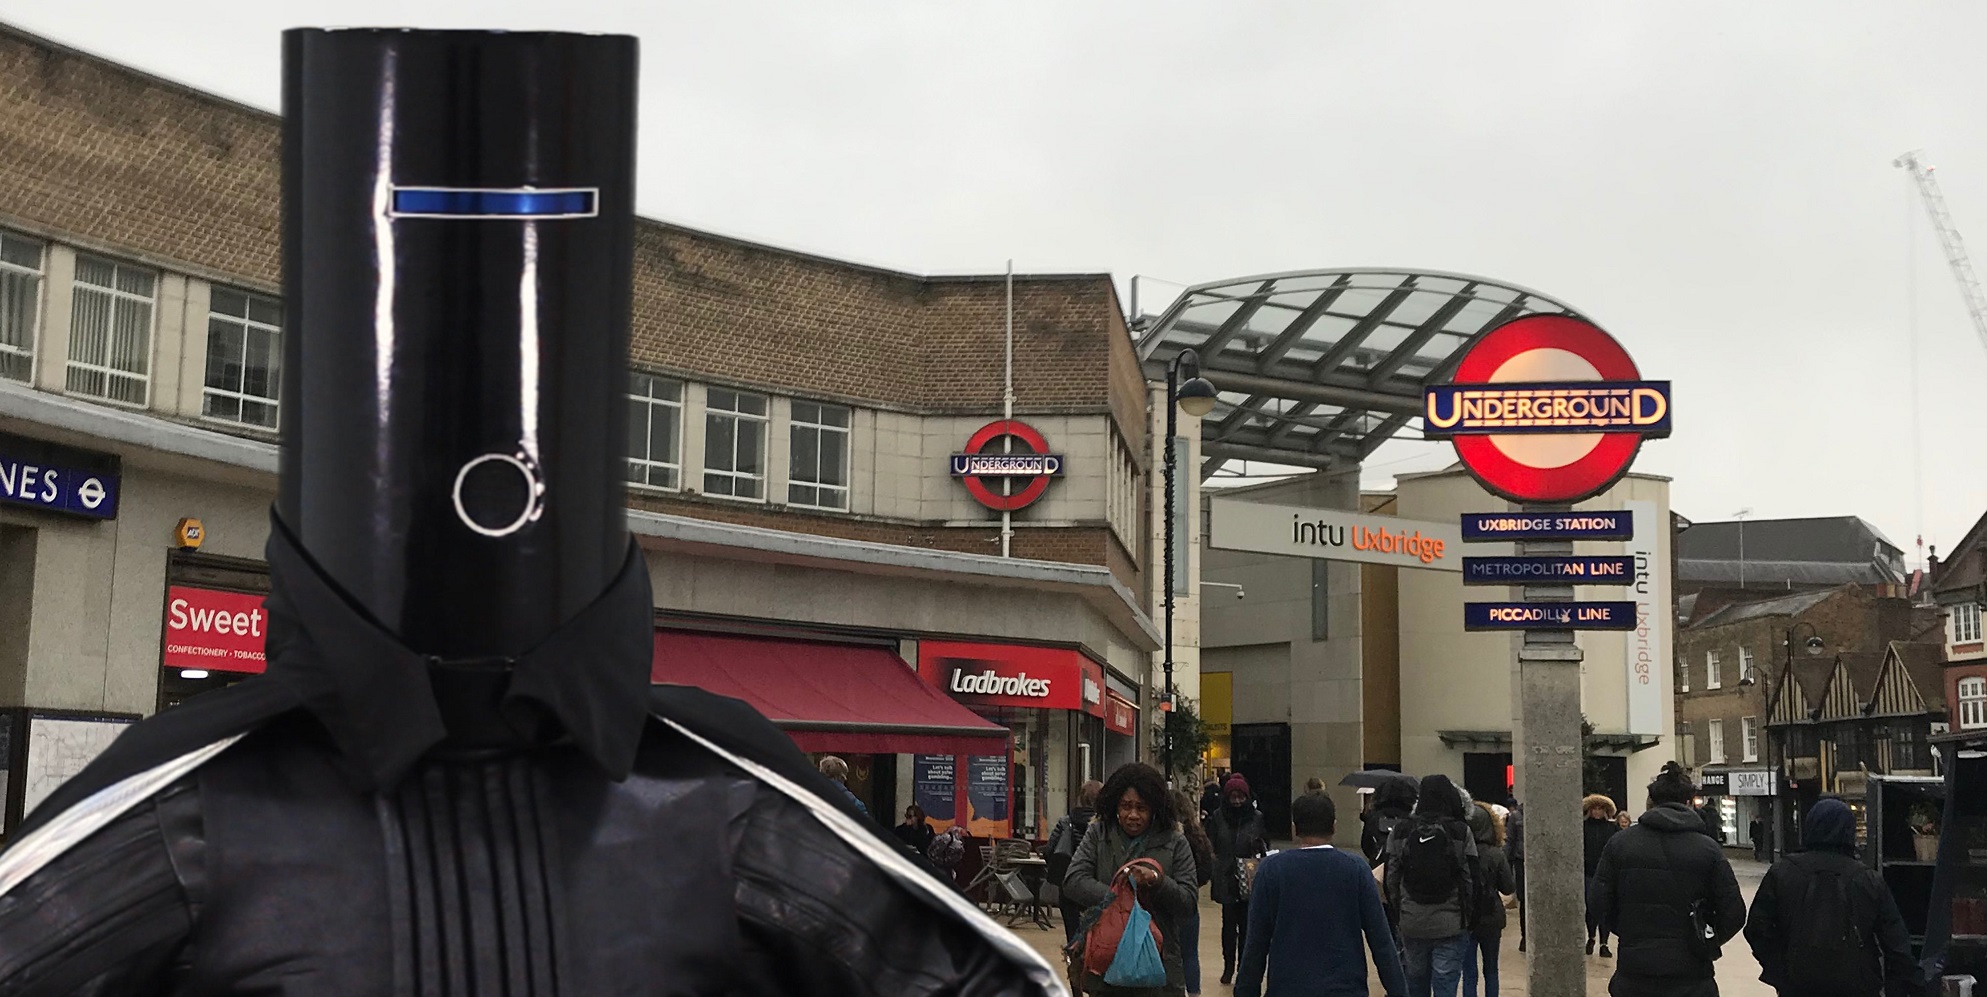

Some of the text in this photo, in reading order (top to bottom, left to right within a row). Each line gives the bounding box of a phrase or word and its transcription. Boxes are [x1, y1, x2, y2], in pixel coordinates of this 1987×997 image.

[1427, 388, 1667, 428] UNDERGROUND
[954, 457, 1059, 474] UNDERGROUND
[1478, 517, 1616, 532] UXBRIDGE STATION
[1293, 513, 1445, 563] intu Uxbridge
[1472, 562, 1624, 576] METROPOLITAN LINE
[169, 598, 262, 637] Sweet
[1489, 608, 1611, 623] PICCADILLY LINE
[1635, 551, 1652, 685] intu Uxbridge
[167, 644, 228, 657] CONFECTIONERY
[950, 668, 1051, 697] Ladbrokes
[1738, 773, 1765, 788] SIMPLY
